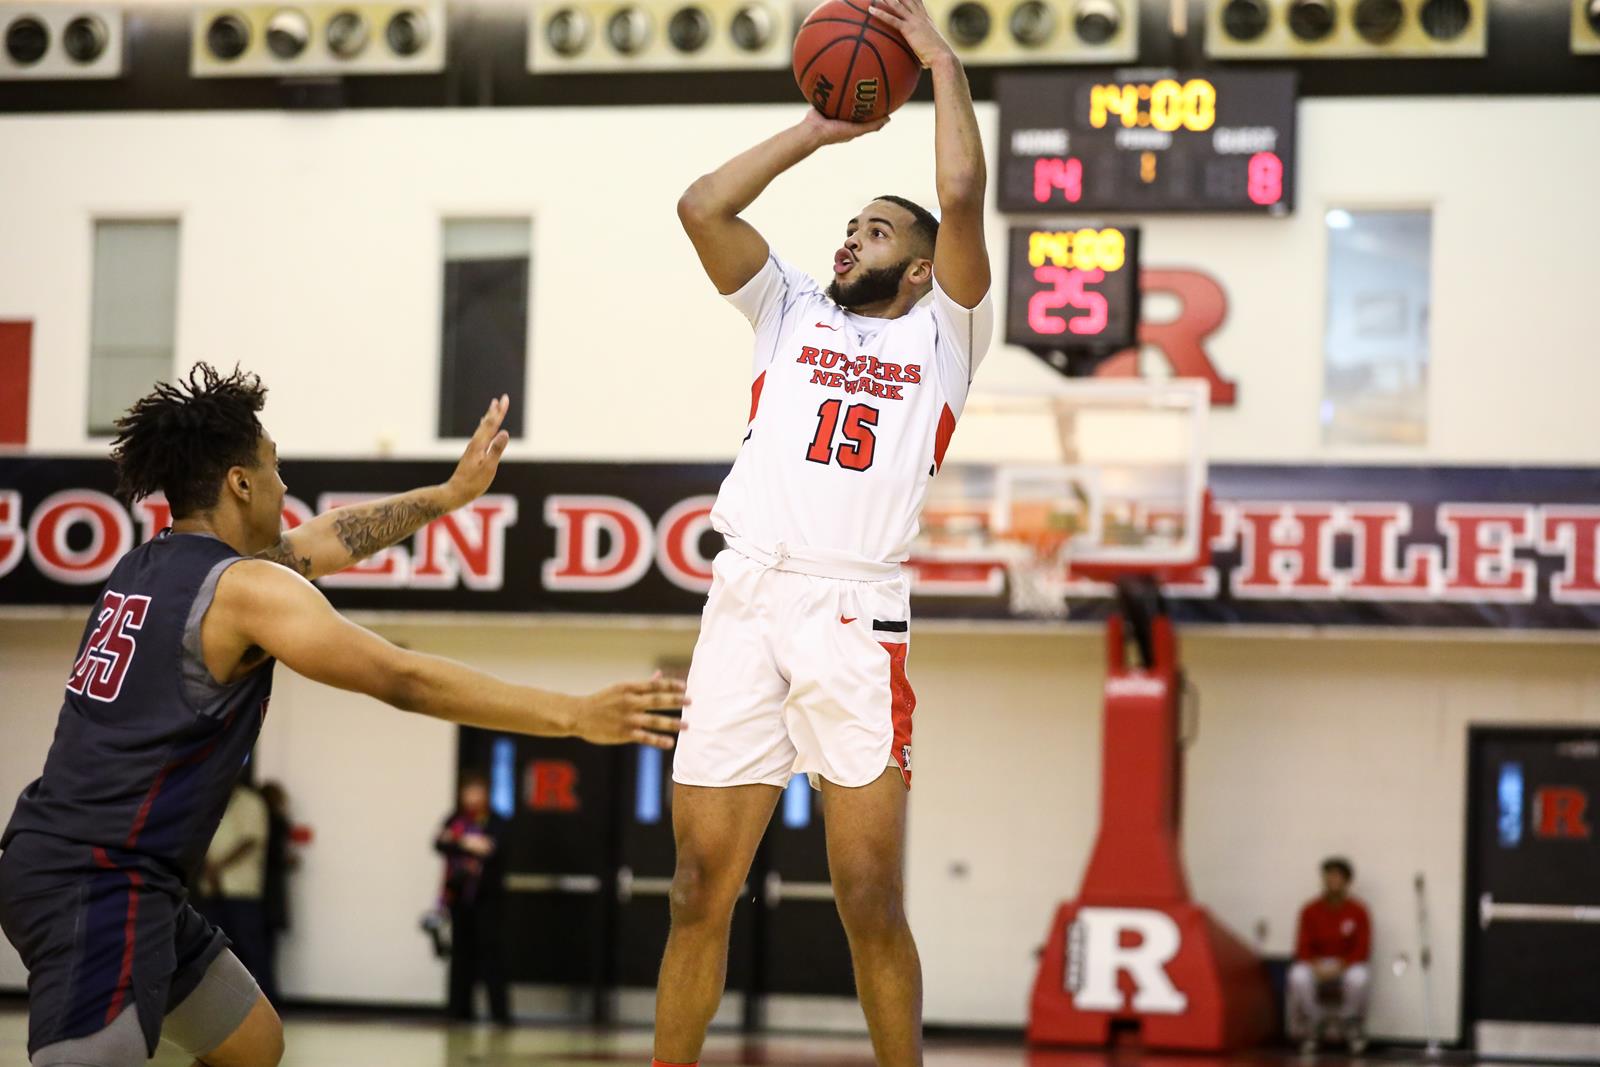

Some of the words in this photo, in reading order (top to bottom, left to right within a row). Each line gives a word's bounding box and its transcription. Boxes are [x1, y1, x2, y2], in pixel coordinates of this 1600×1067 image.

[1089, 79, 1216, 131] 14:00
[1034, 157, 1082, 203] 14
[1028, 228, 1126, 271] 14:00
[1091, 267, 1237, 406] R
[796, 345, 922, 385] RUTGERS
[810, 369, 904, 401] NEWARK
[805, 398, 880, 472] 15
[66, 589, 152, 703] 25
[529, 760, 578, 811] R
[1537, 786, 1588, 838] R
[1073, 906, 1187, 1015] R
